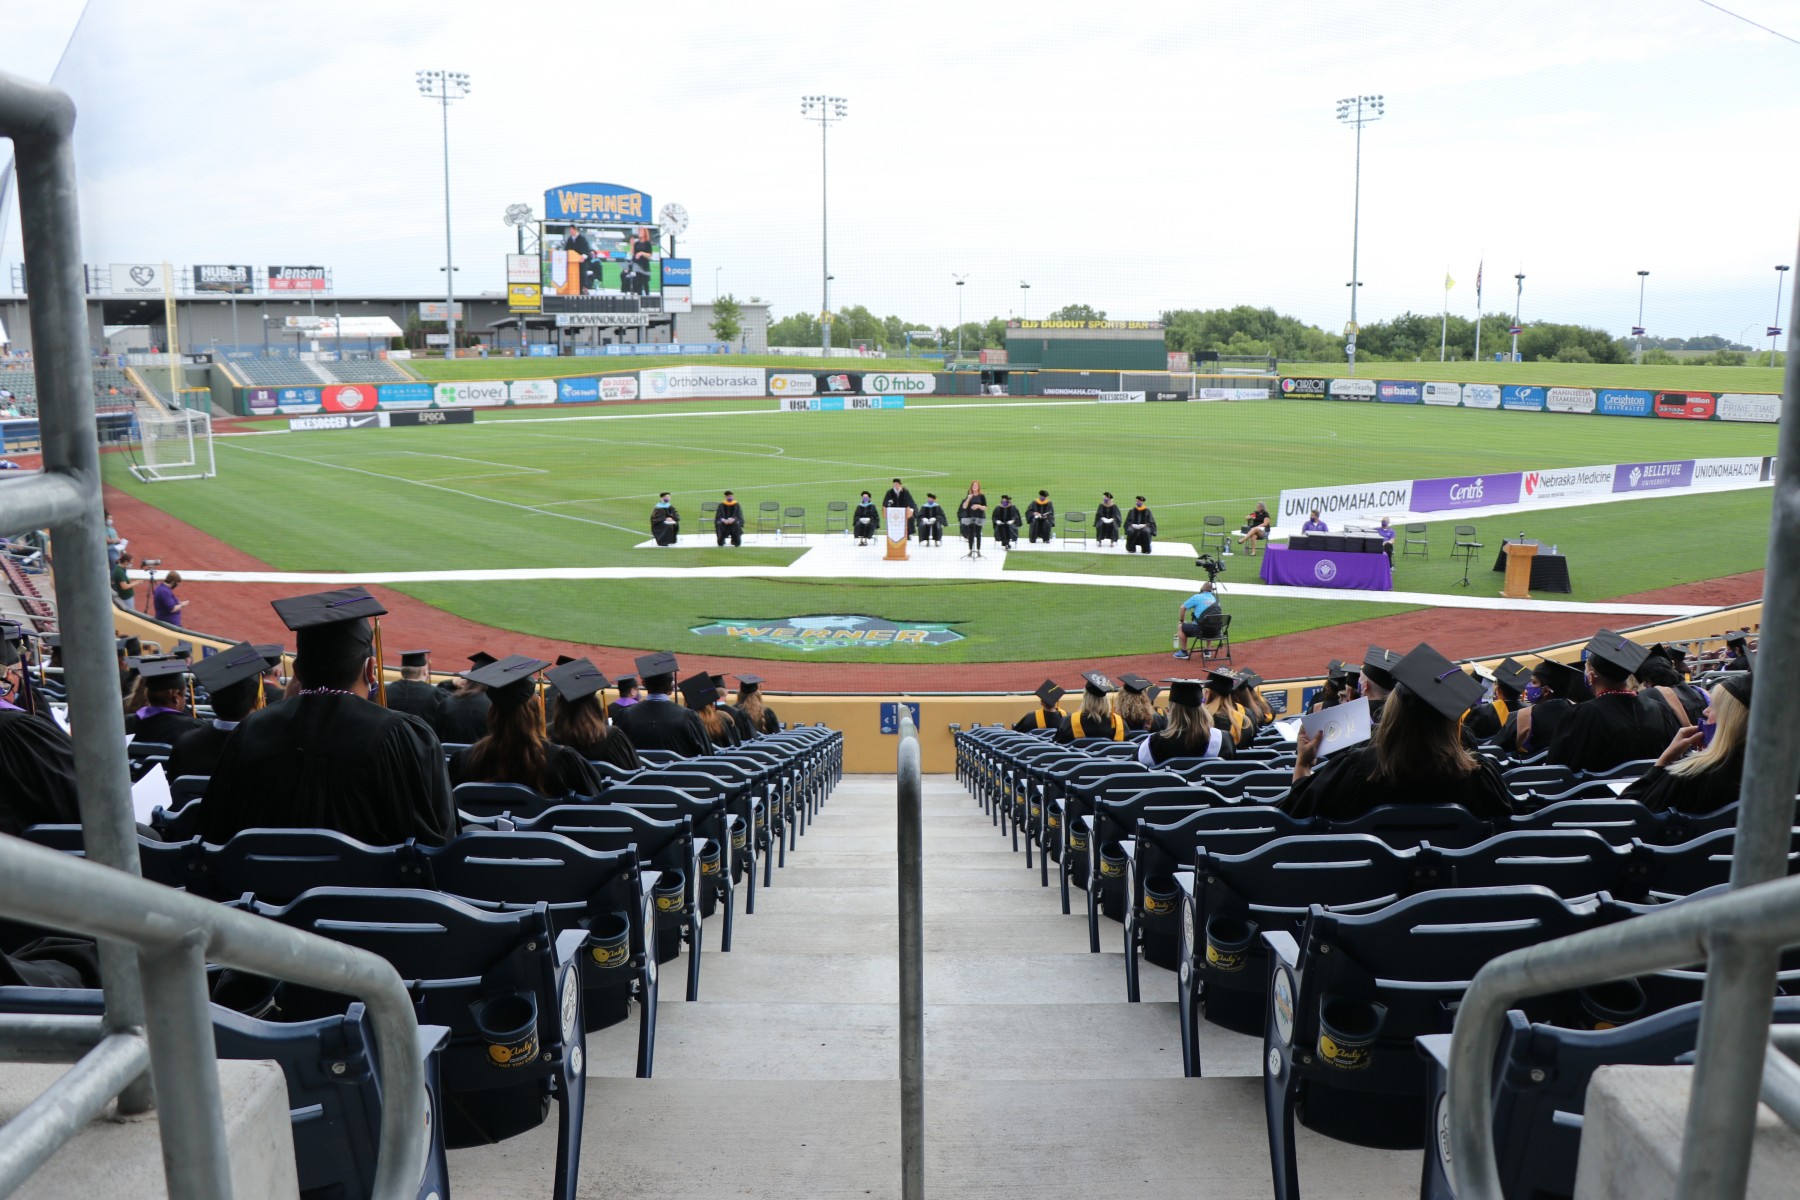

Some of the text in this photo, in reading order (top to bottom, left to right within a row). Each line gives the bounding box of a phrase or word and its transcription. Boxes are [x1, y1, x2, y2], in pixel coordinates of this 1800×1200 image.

[557, 189, 642, 217] WERNER
[201, 266, 247, 277] HUBER
[276, 265, 323, 279] Jensen
[573, 315, 648, 324] DOWNDRAUGHT
[1041, 320, 1086, 328] DUGOUT
[1088, 320, 1126, 329] SPORTS
[1128, 321, 1149, 329] BAR
[669, 375, 758, 387] OrthoNebraska
[892, 377, 925, 390] fnbo
[1295, 379, 1325, 389] CURZON
[458, 385, 503, 399] clover
[1472, 388, 1493, 399] SOS
[1548, 395, 1594, 403] STEAMROLLER
[1604, 394, 1645, 406] Creighton
[1723, 404, 1775, 414] PRIME TIME
[418, 411, 446, 421] EPOCA
[289, 416, 348, 430] NIKESOCCER
[1643, 464, 1682, 477] BELLEVUE
[1694, 463, 1760, 478] UNIONOMAHA.COM
[1539, 471, 1611, 488] Nebraska Medicine
[1641, 478, 1671, 486] UNIVERSITY
[1449, 482, 1484, 501] Centris
[1285, 489, 1406, 516] UNIONOMAHA.COM
[726, 625, 930, 643] WERNER
[510, 1037, 536, 1057] Andy's
[1336, 1048, 1368, 1060] Andy's
